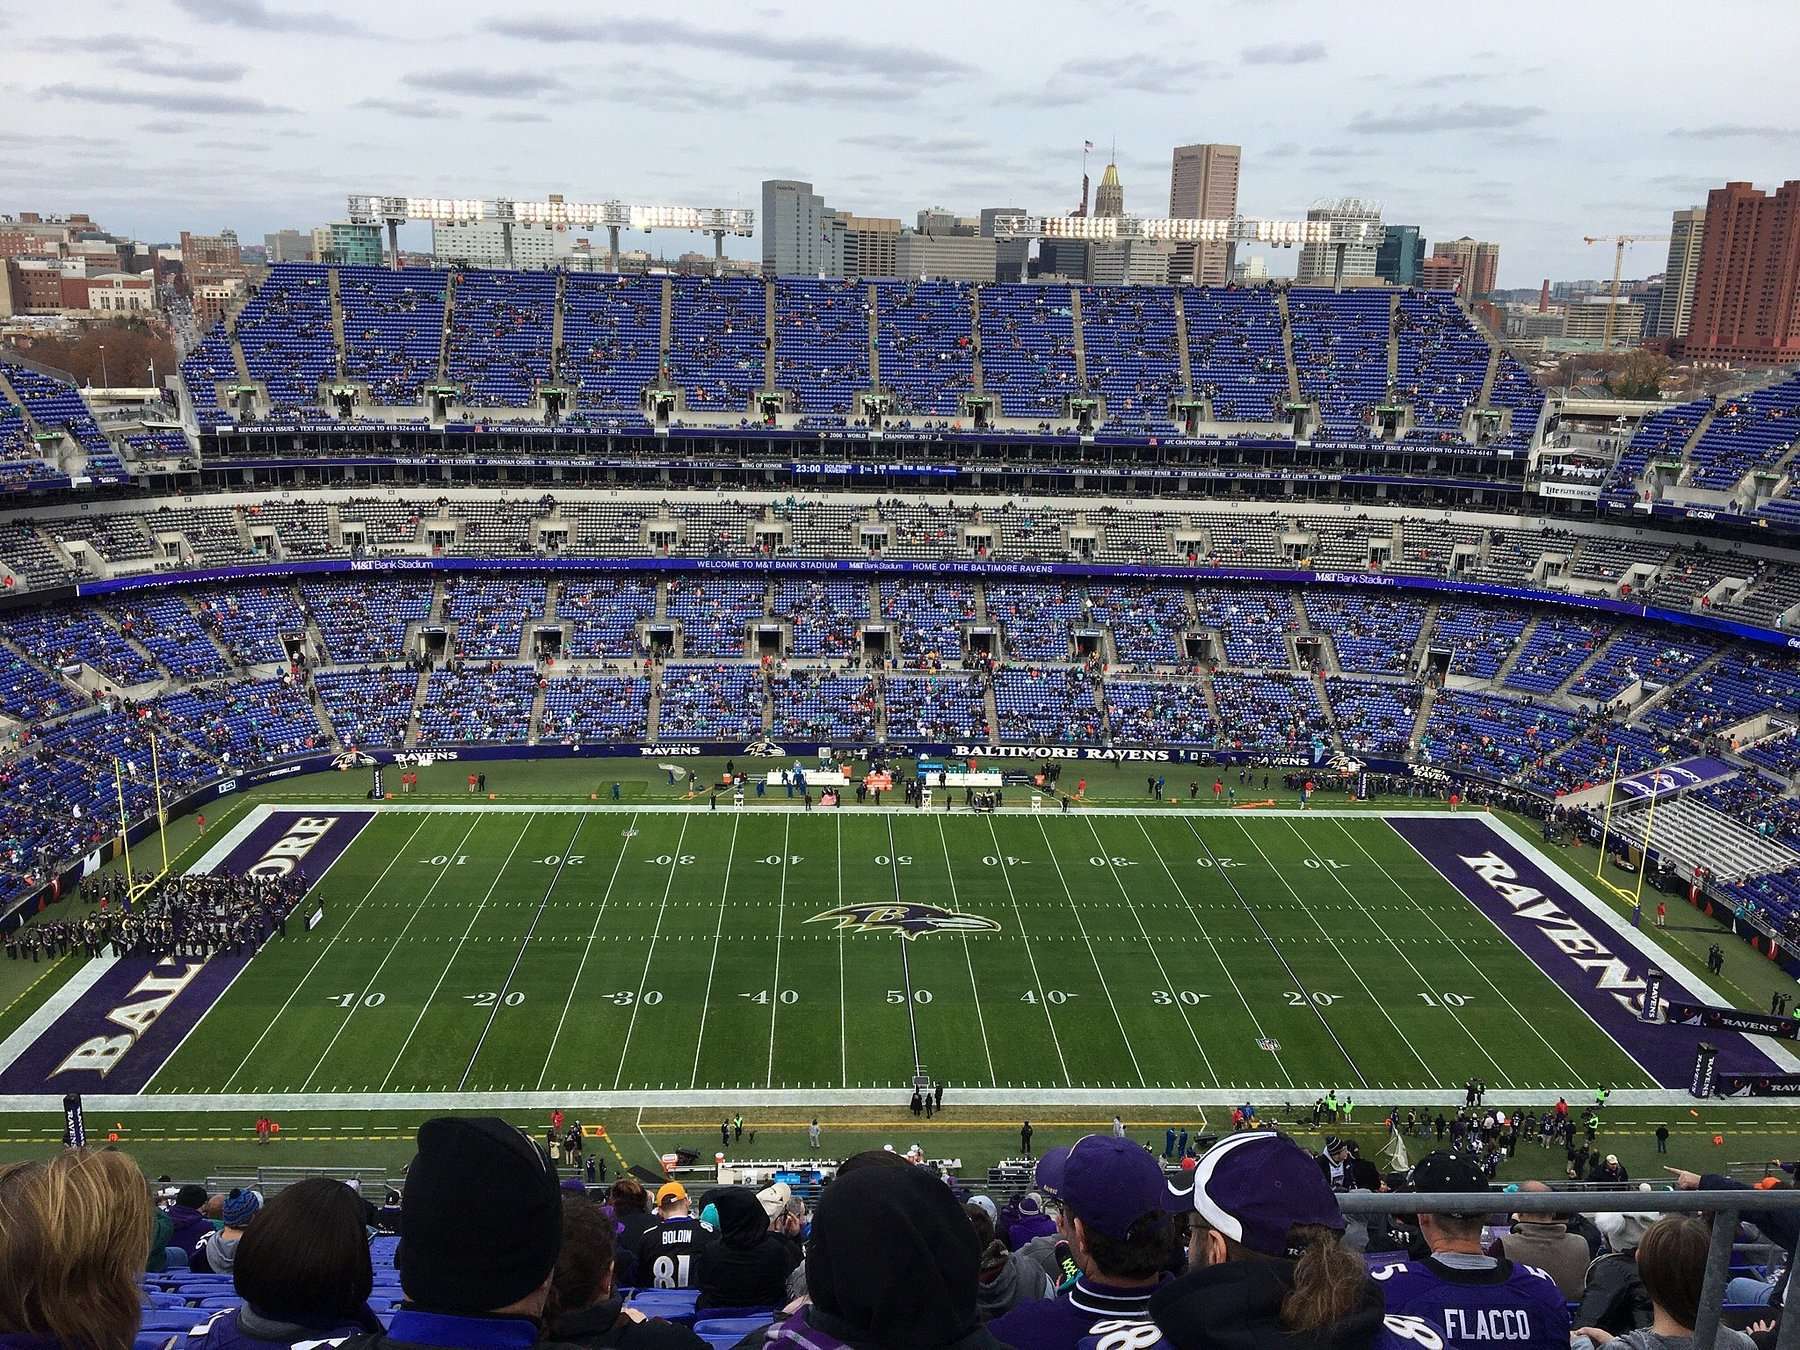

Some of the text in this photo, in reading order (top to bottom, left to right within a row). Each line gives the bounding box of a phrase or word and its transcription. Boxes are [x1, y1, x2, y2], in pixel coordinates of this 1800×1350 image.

[796, 464, 821, 472] 23:00
[1546, 486, 1559, 495] Lite
[1697, 511, 1715, 519] CSN
[351, 560, 433, 570] M&T Bank Stadium
[697, 561, 740, 569] WELCOME
[912, 563, 936, 571] HOME
[970, 564, 1018, 572] BALTIMORE
[1020, 565, 1053, 573] RAVENS
[1315, 573, 1394, 585] M&T Bank Stadium
[393, 752, 458, 761] RAVENS
[640, 747, 700, 756] RAVENS
[955, 745, 1169, 761] BALTIMORE RAVENS
[1413, 770, 1450, 781] RAVEN
[430, 855, 469, 865] 10
[543, 855, 585, 865] 20
[655, 855, 696, 865] 30
[766, 855, 805, 865] 40
[875, 855, 912, 866] 50
[982, 856, 1021, 866] 40
[1090, 857, 1130, 867] 30
[1197, 857, 1237, 868] 20
[1303, 859, 1342, 869] 10
[336, 992, 386, 1008] 10
[472, 991, 525, 1007] 20
[613, 991, 663, 1006] 30
[751, 990, 799, 1004] 40
[886, 990, 933, 1004] 50
[1020, 990, 1066, 1004] 40
[1151, 990, 1200, 1006] 30
[1283, 991, 1333, 1006] 20
[1417, 992, 1465, 1007] 10
[1649, 981, 1659, 1018] RAVENS
[1722, 1018, 1778, 1032] RAVENS
[1702, 1056, 1715, 1096] RAVENS
[662, 1230, 692, 1244] BOLDIN
[653, 1255, 690, 1288] 81
[1371, 1263, 1408, 1280] 5
[1444, 1309, 1531, 1340] FLACCO
